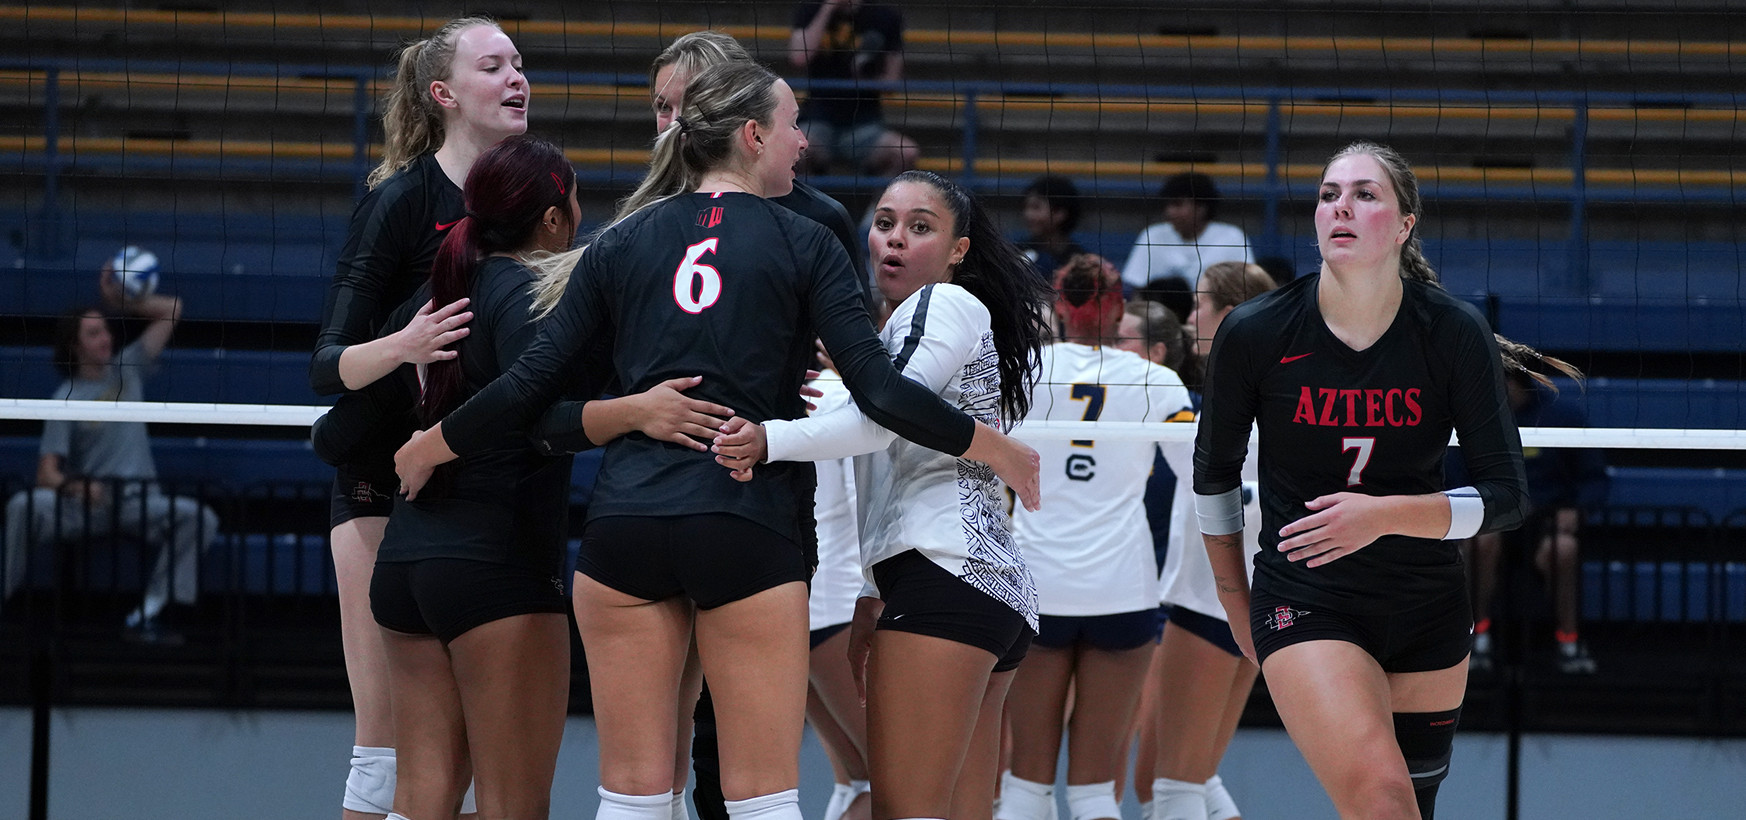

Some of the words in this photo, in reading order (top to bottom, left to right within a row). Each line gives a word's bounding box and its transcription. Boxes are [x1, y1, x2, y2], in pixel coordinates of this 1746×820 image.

[673, 237, 722, 314] 6
[1070, 382, 1107, 448] 7
[1292, 386, 1422, 427] AZTECS
[1066, 454, 1096, 481] C
[1342, 437, 1376, 488] 7
